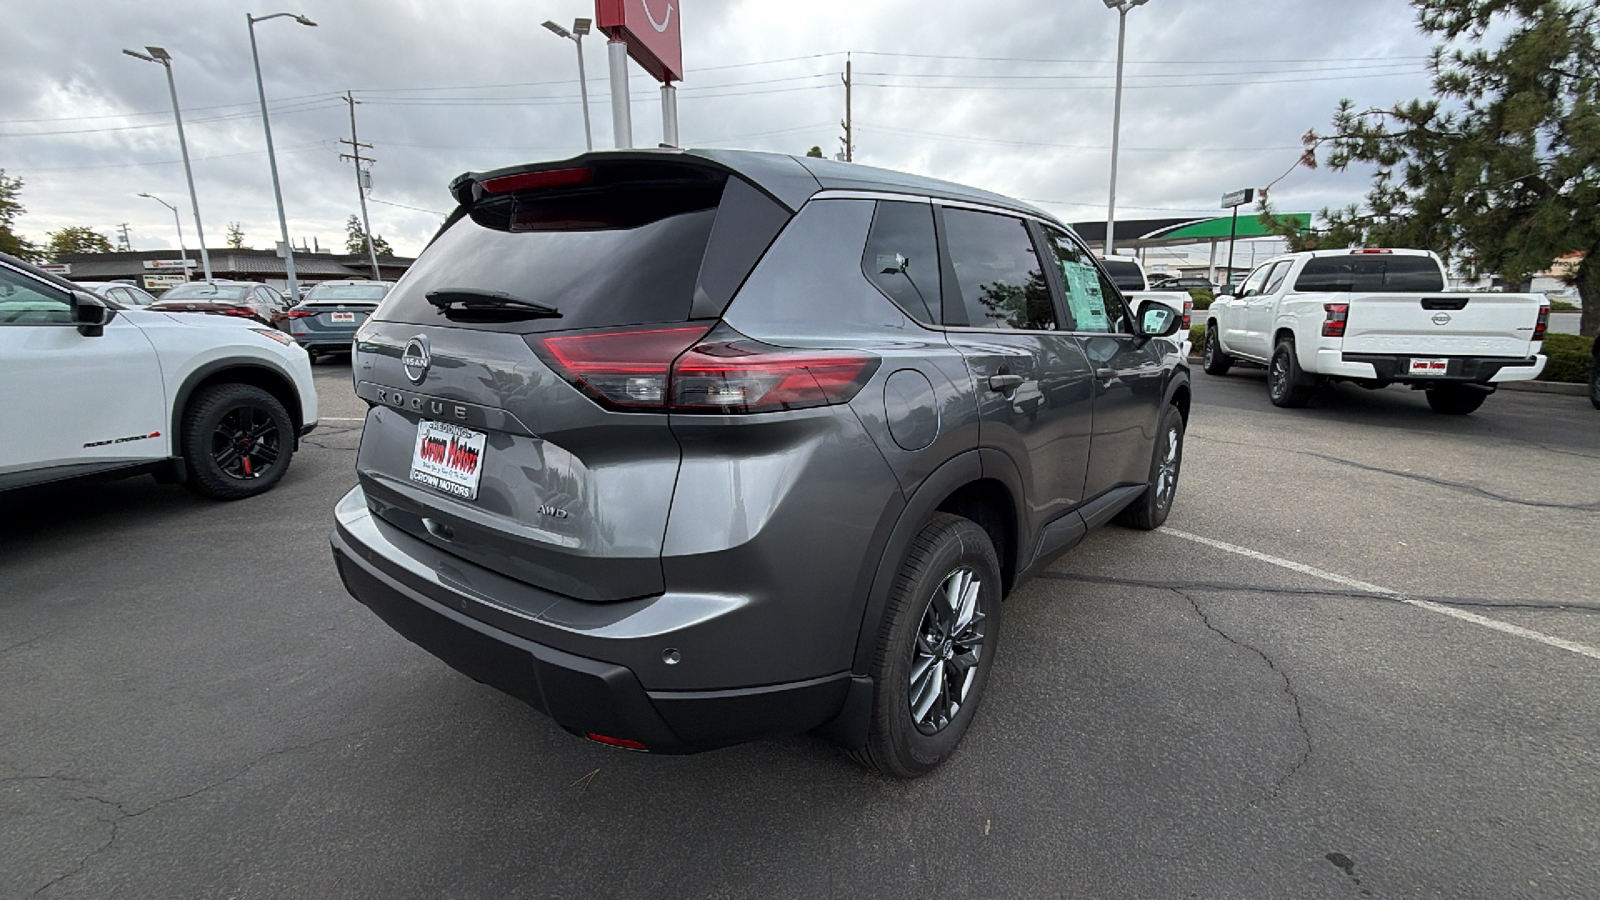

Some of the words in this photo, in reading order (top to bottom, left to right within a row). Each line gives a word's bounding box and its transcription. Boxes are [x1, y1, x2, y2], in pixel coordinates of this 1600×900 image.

[377, 388, 467, 420] ROGUE
[420, 435, 447, 465] Crown
[446, 435, 480, 475] Motors
[413, 471, 438, 487] CROWN
[439, 479, 470, 497] MOTORS
[538, 504, 568, 519] AWD
